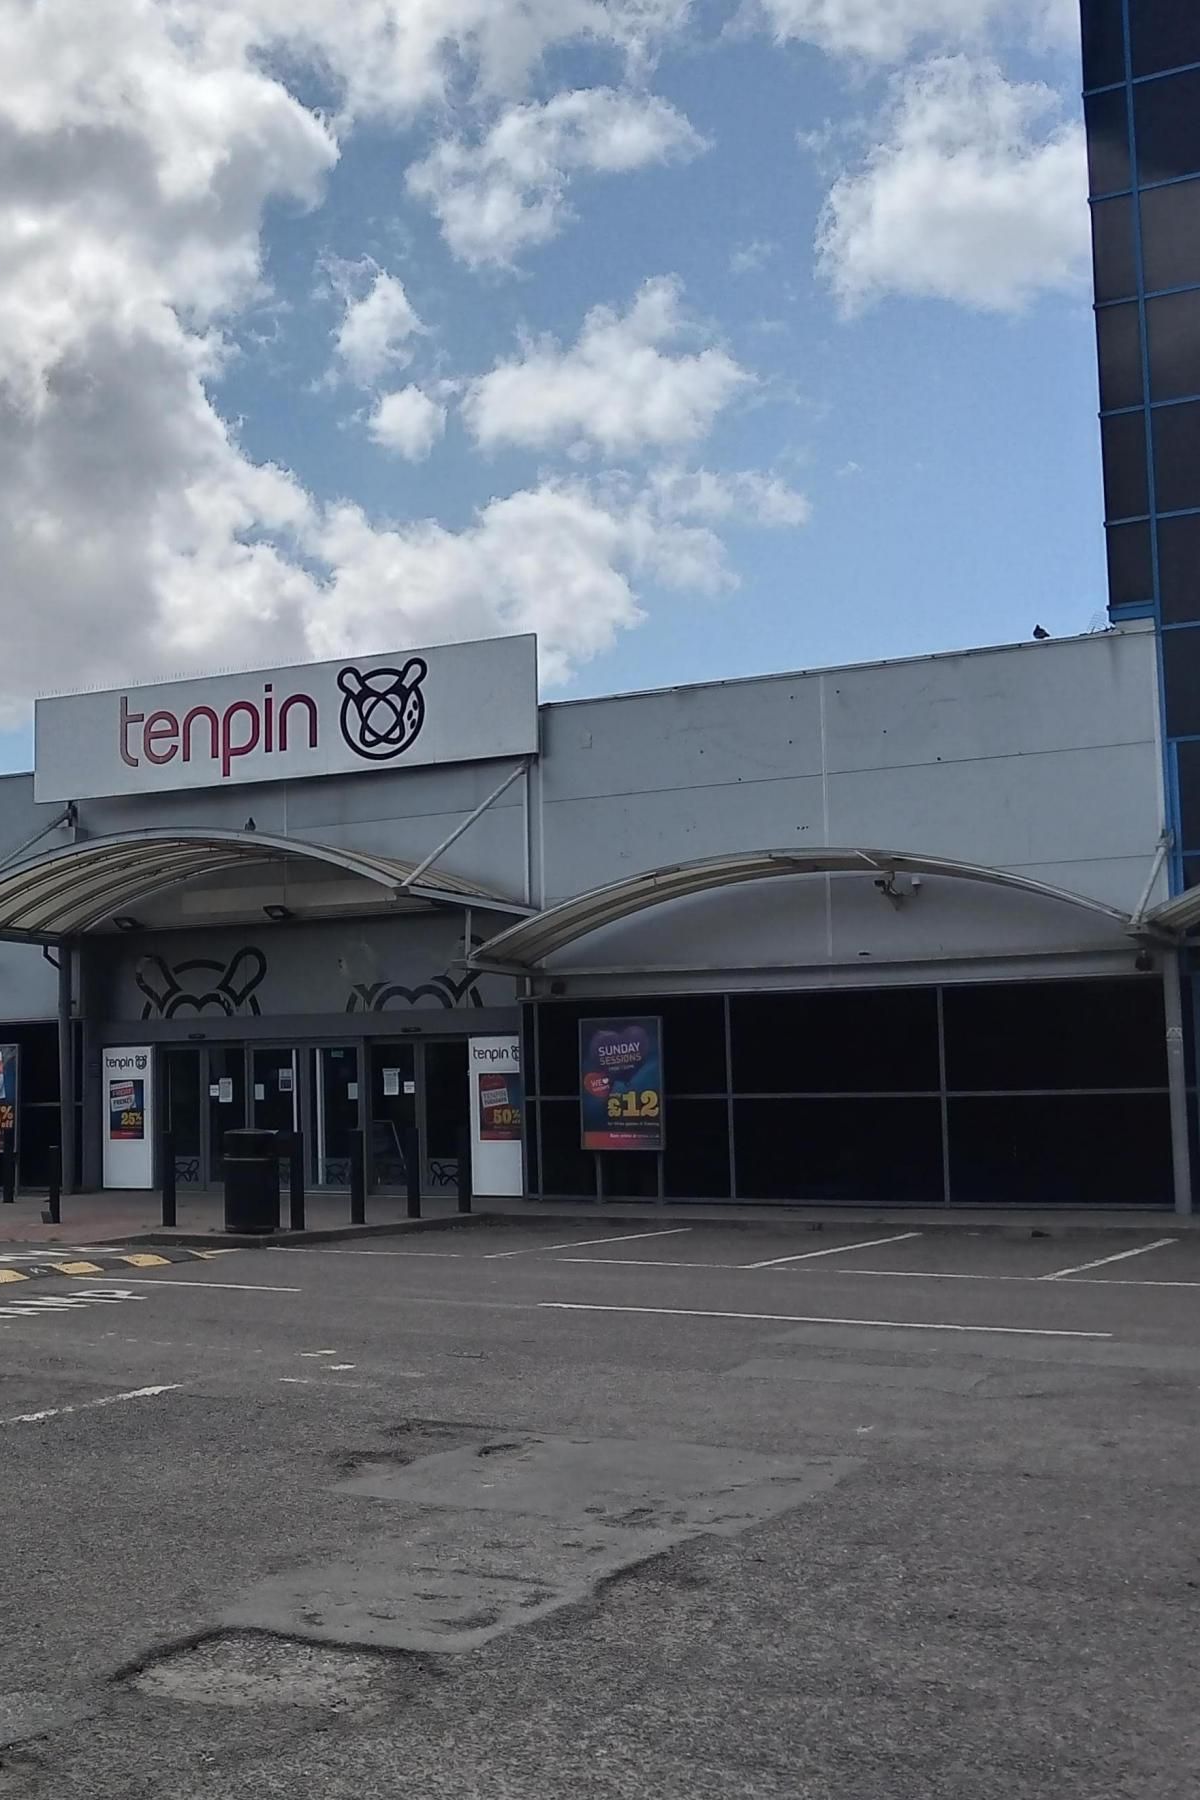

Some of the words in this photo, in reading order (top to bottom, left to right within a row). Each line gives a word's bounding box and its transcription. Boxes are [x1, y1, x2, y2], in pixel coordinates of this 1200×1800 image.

[119, 683, 318, 777] tenpin
[472, 1046, 509, 1062] tenpin
[598, 1042, 641, 1057] SUNDAY
[105, 1056, 134, 1070] tenpin
[599, 1052, 642, 1066] SESSIONS
[607, 1090, 660, 1118] £12
[1, 1119, 13, 1129] off
[121, 1112, 143, 1126] 25%
[493, 1108, 520, 1125] 50%
